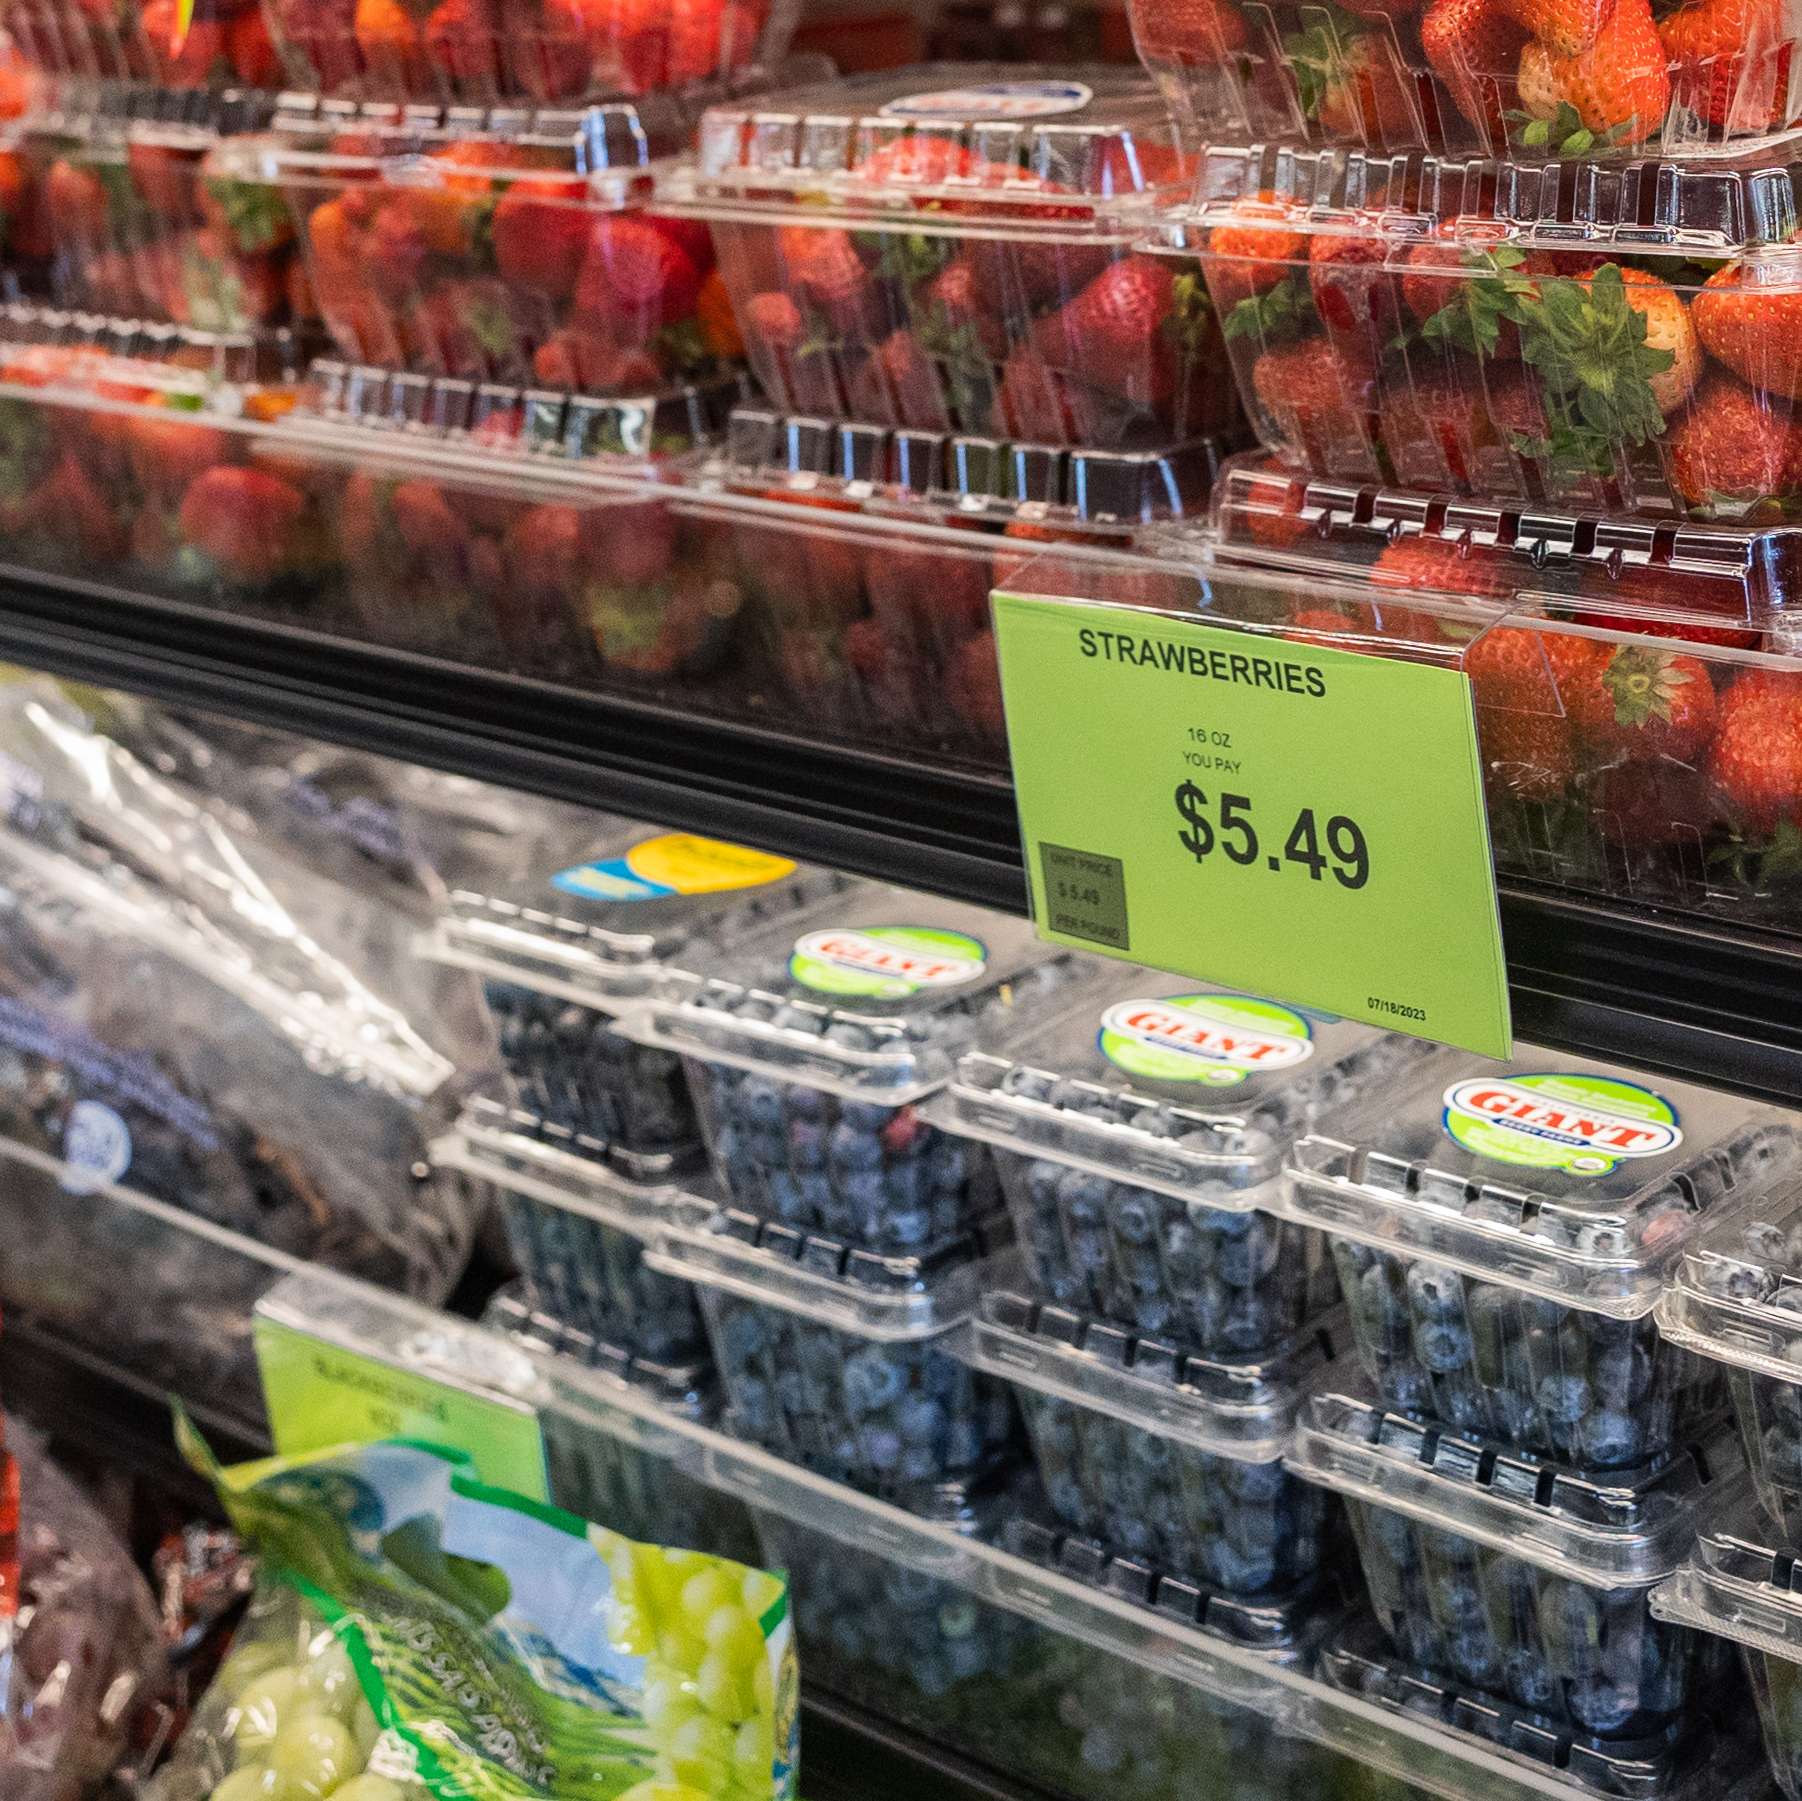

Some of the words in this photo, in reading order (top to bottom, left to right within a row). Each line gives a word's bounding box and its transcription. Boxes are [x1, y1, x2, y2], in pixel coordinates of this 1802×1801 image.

[1078, 627, 1327, 699] STRAWBERRIES
[1187, 726, 1208, 745] 16
[1210, 729, 1233, 750] OZ
[1181, 751, 1214, 771] YOU
[1215, 755, 1243, 776] PAY
[1173, 778, 1371, 891] $5.49
[1366, 996, 1428, 1023] 07/18/2023
[1126, 1012, 1288, 1060] GIANT
[1469, 1091, 1657, 1149] GIANT
